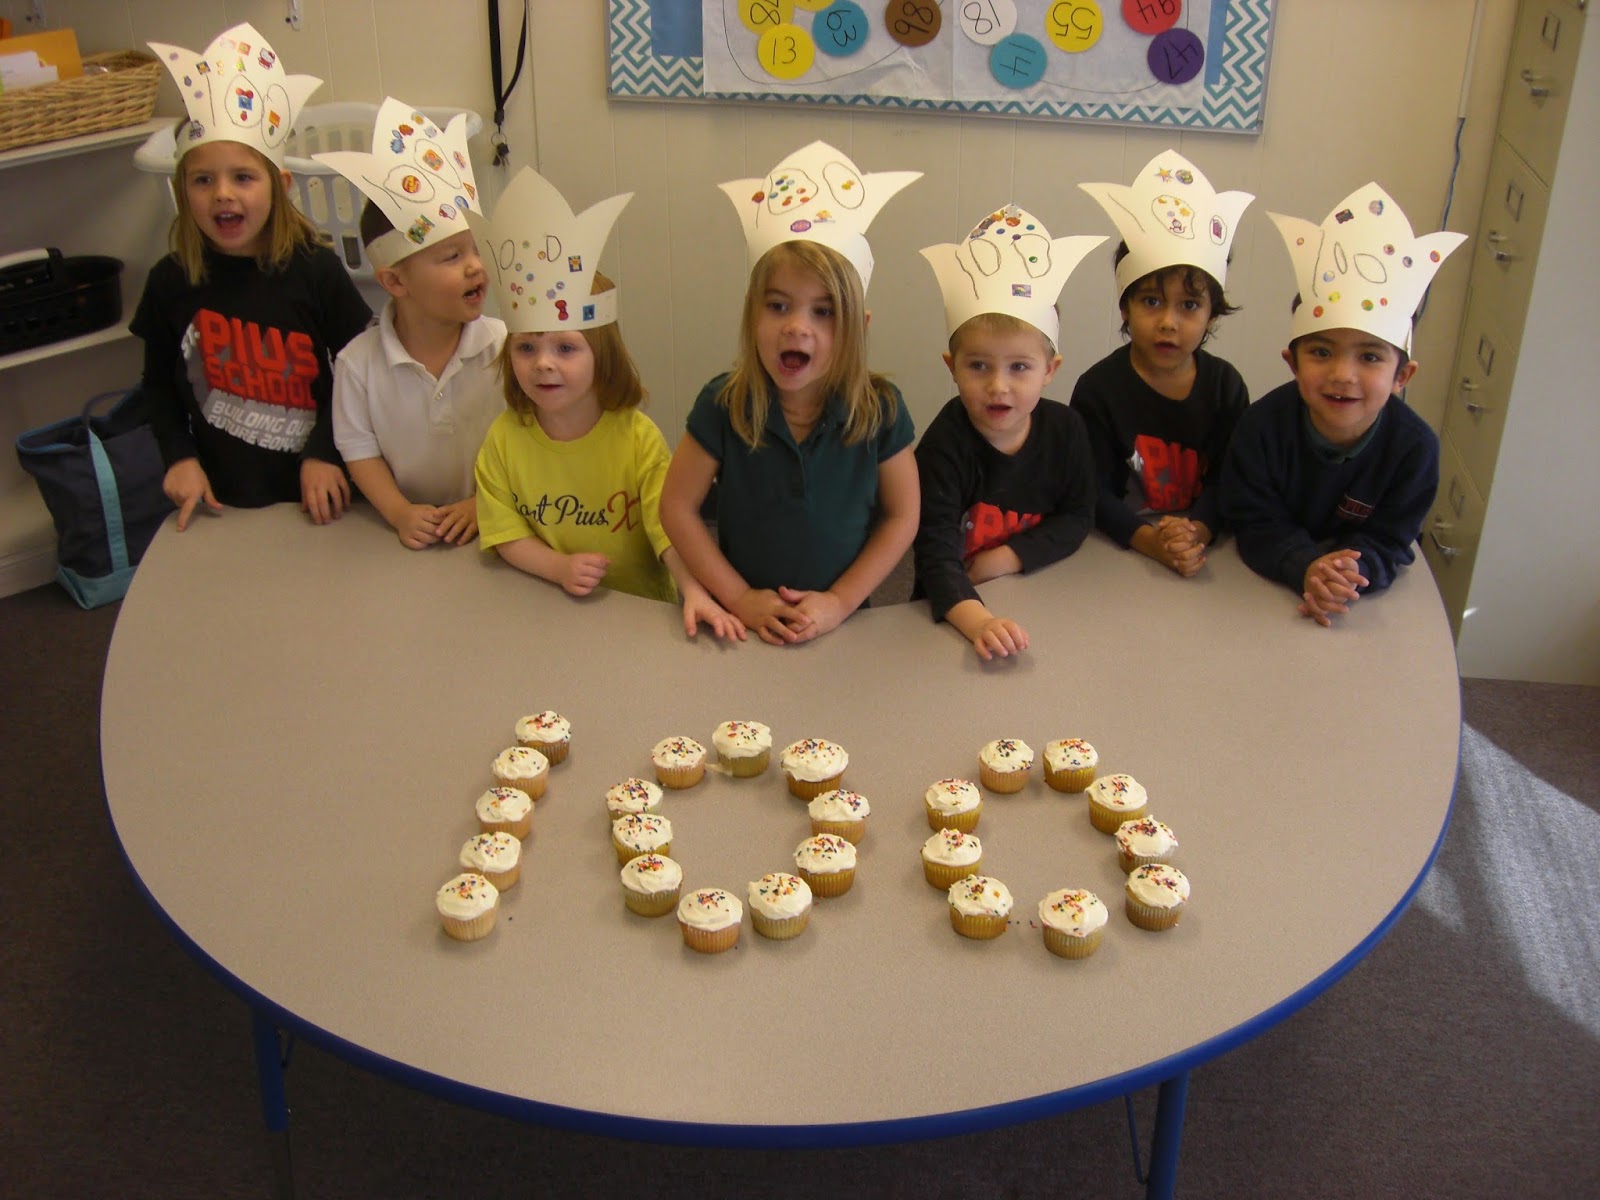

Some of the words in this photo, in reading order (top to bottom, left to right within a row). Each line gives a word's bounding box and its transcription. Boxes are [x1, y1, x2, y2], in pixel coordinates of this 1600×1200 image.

[826, 9, 857, 48] 63
[1052, 1, 1096, 40] 55
[772, 36, 797, 65] 13
[1311, 229, 1388, 298] 100
[193, 308, 320, 378] PIUS
[206, 414, 259, 445] FUTURE
[211, 400, 286, 434] BUILDING
[554, 493, 609, 526] Pius
[606, 490, 641, 534] X
